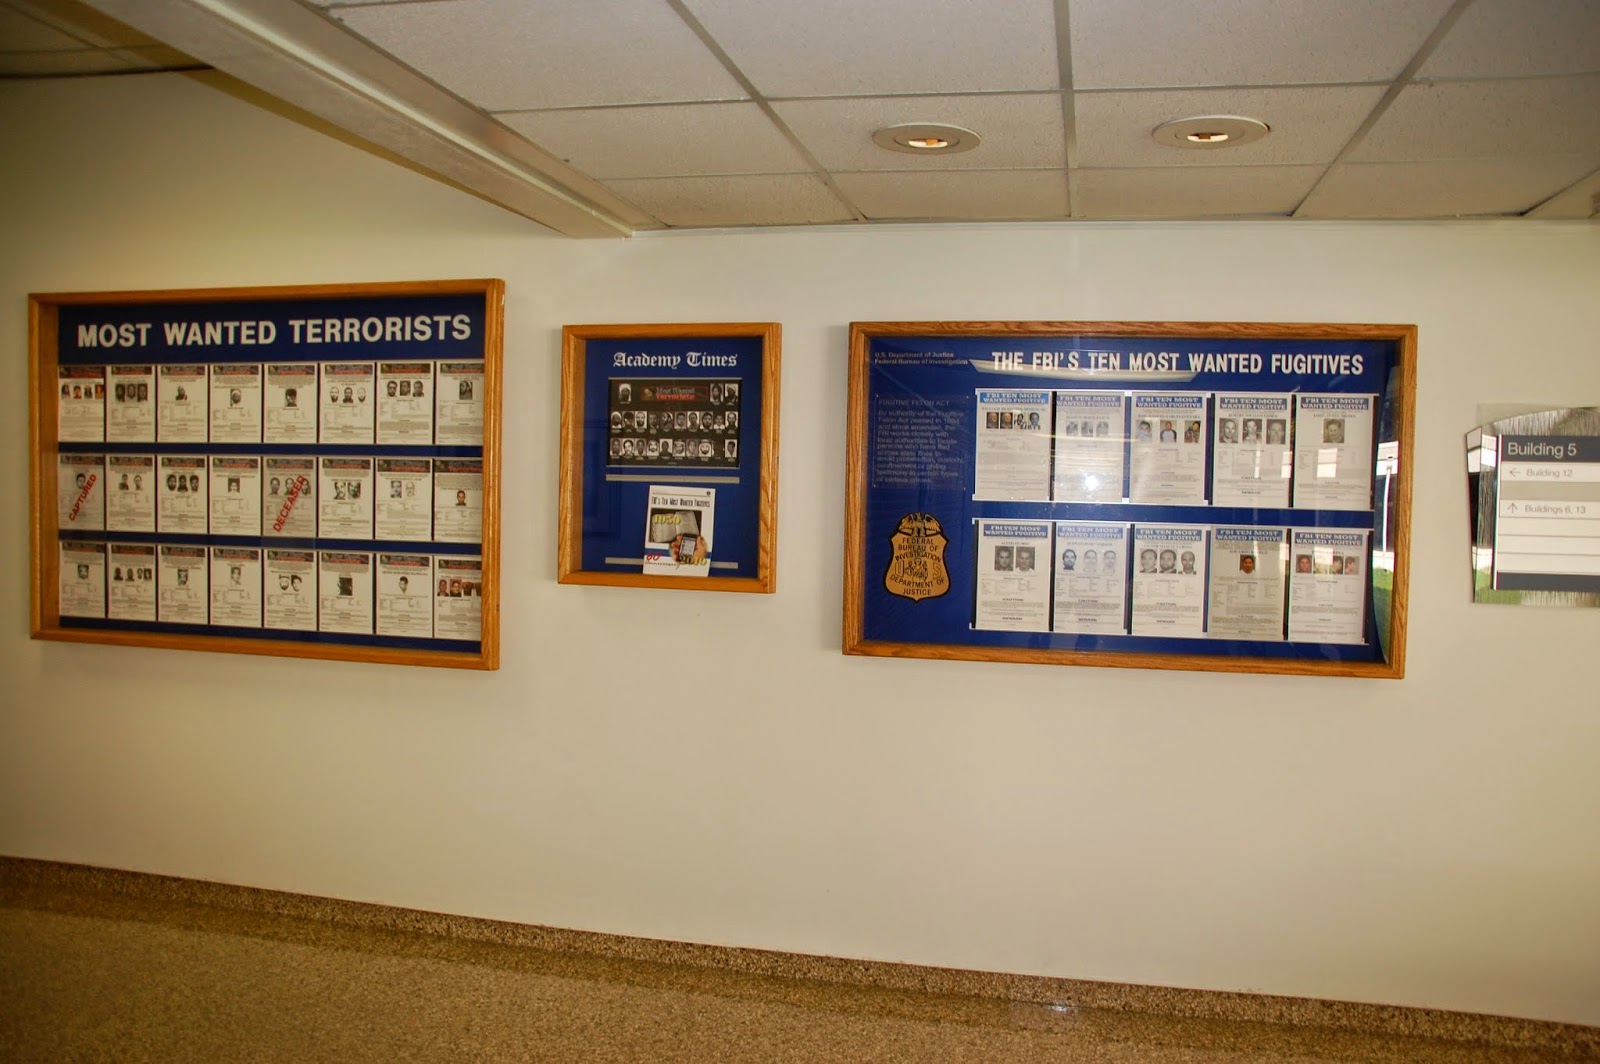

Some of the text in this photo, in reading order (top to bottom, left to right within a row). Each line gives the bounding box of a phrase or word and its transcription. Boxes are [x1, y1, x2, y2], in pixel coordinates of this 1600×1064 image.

[77, 314, 471, 348] MOST WANTED TERRORISTS
[613, 352, 738, 369] Academy Times
[992, 351, 1023, 371] THE
[1087, 352, 1119, 372] TEN
[1129, 352, 1180, 373] MOST
[1189, 352, 1263, 374] WANTED
[1271, 353, 1364, 376] FUGITIVES
[1507, 442, 1577, 459] Building 5
[1526, 468, 1573, 478] Building 12
[69, 473, 97, 521] CAPTURED
[273, 475, 306, 532] DECEASED
[1524, 504, 1563, 514] Buildings
[1576, 506, 1586, 514] 13
[654, 515, 681, 525] 1950
[902, 537, 934, 545] FEDERAL
[680, 556, 707, 565] 2010
[895, 551, 941, 563] INVESTIGATION
[890, 574, 933, 588] DEPARTMENT
